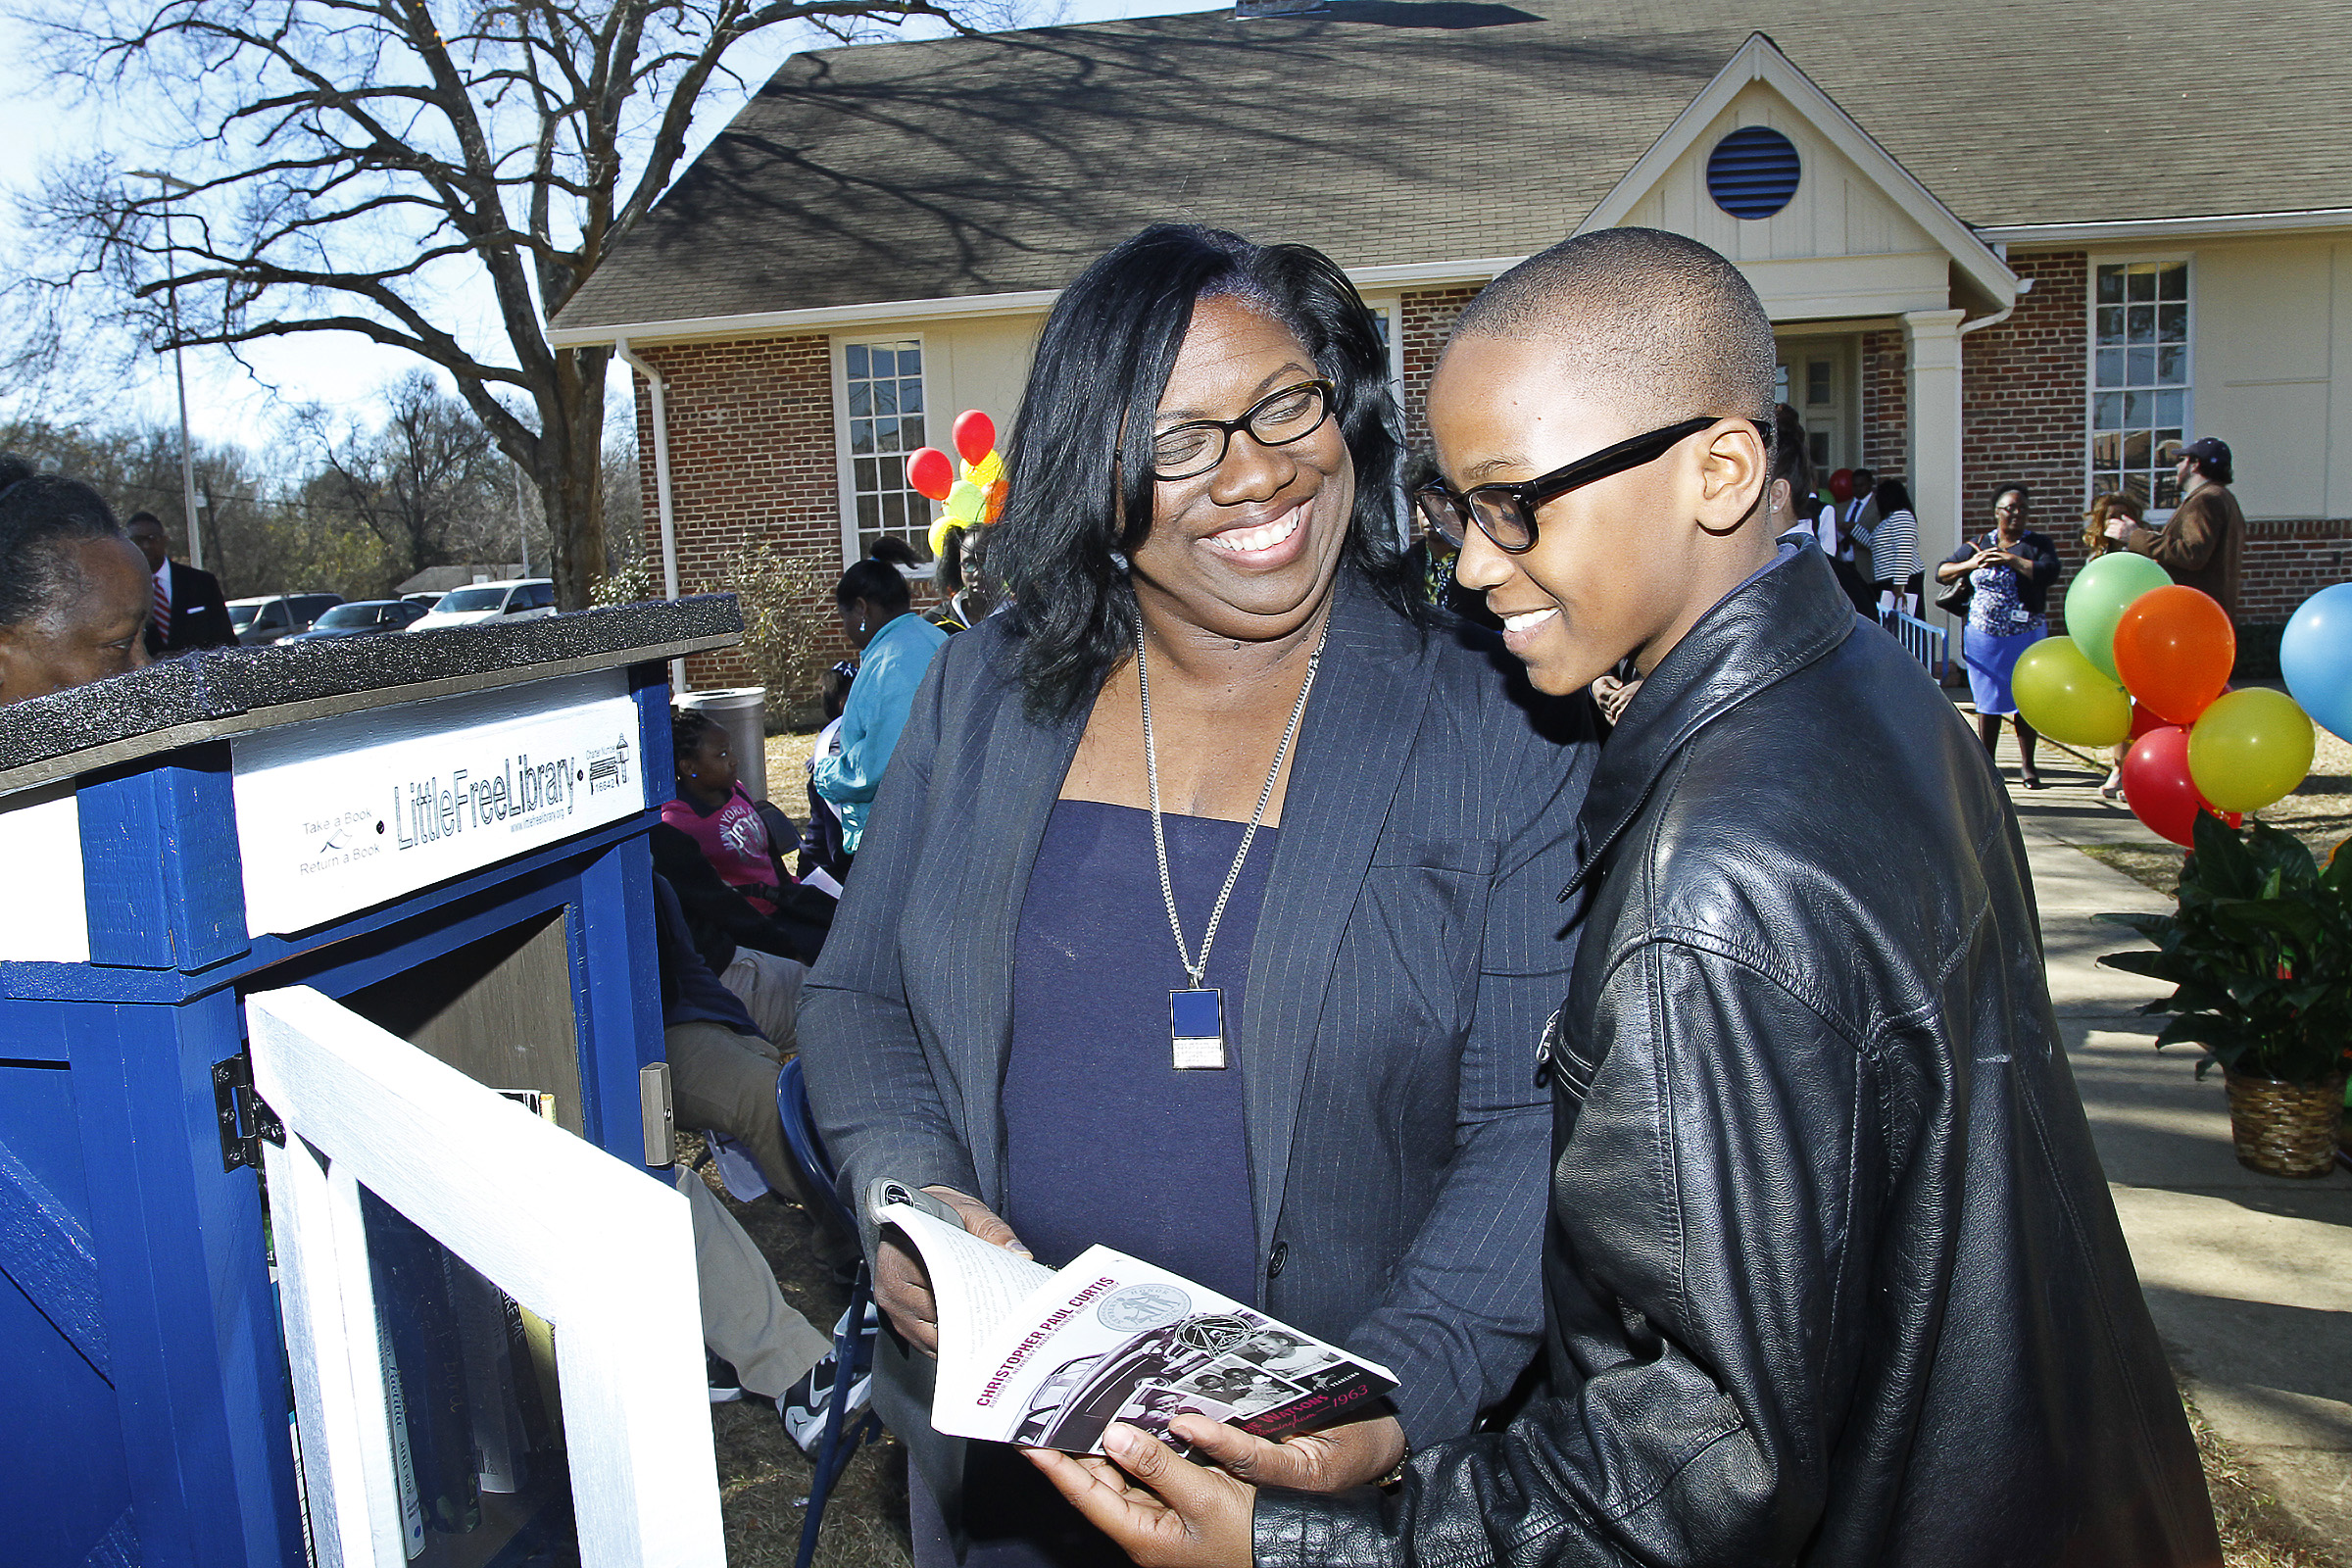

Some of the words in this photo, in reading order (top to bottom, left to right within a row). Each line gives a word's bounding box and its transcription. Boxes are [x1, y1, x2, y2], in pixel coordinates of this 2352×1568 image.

[595, 778, 615, 793] 16642
[394, 754, 575, 851] LittleFreeLibrary
[302, 820, 330, 835] Take
[334, 817, 341, 827] a
[344, 808, 372, 825] Book
[300, 860, 339, 876] Return
[343, 854, 350, 863] a
[353, 843, 380, 860] Book
[976, 1331, 1046, 1406] CHRISTOPHER
[1040, 1308, 1074, 1331] PAUL
[1068, 1276, 1115, 1307] CURTIS
[988, 1384, 1007, 1408] AUTHOR
[1089, 1295, 1102, 1305] NOT
[1100, 1281, 1121, 1296] BUDDY
[1257, 1393, 1330, 1424] WATSONS
